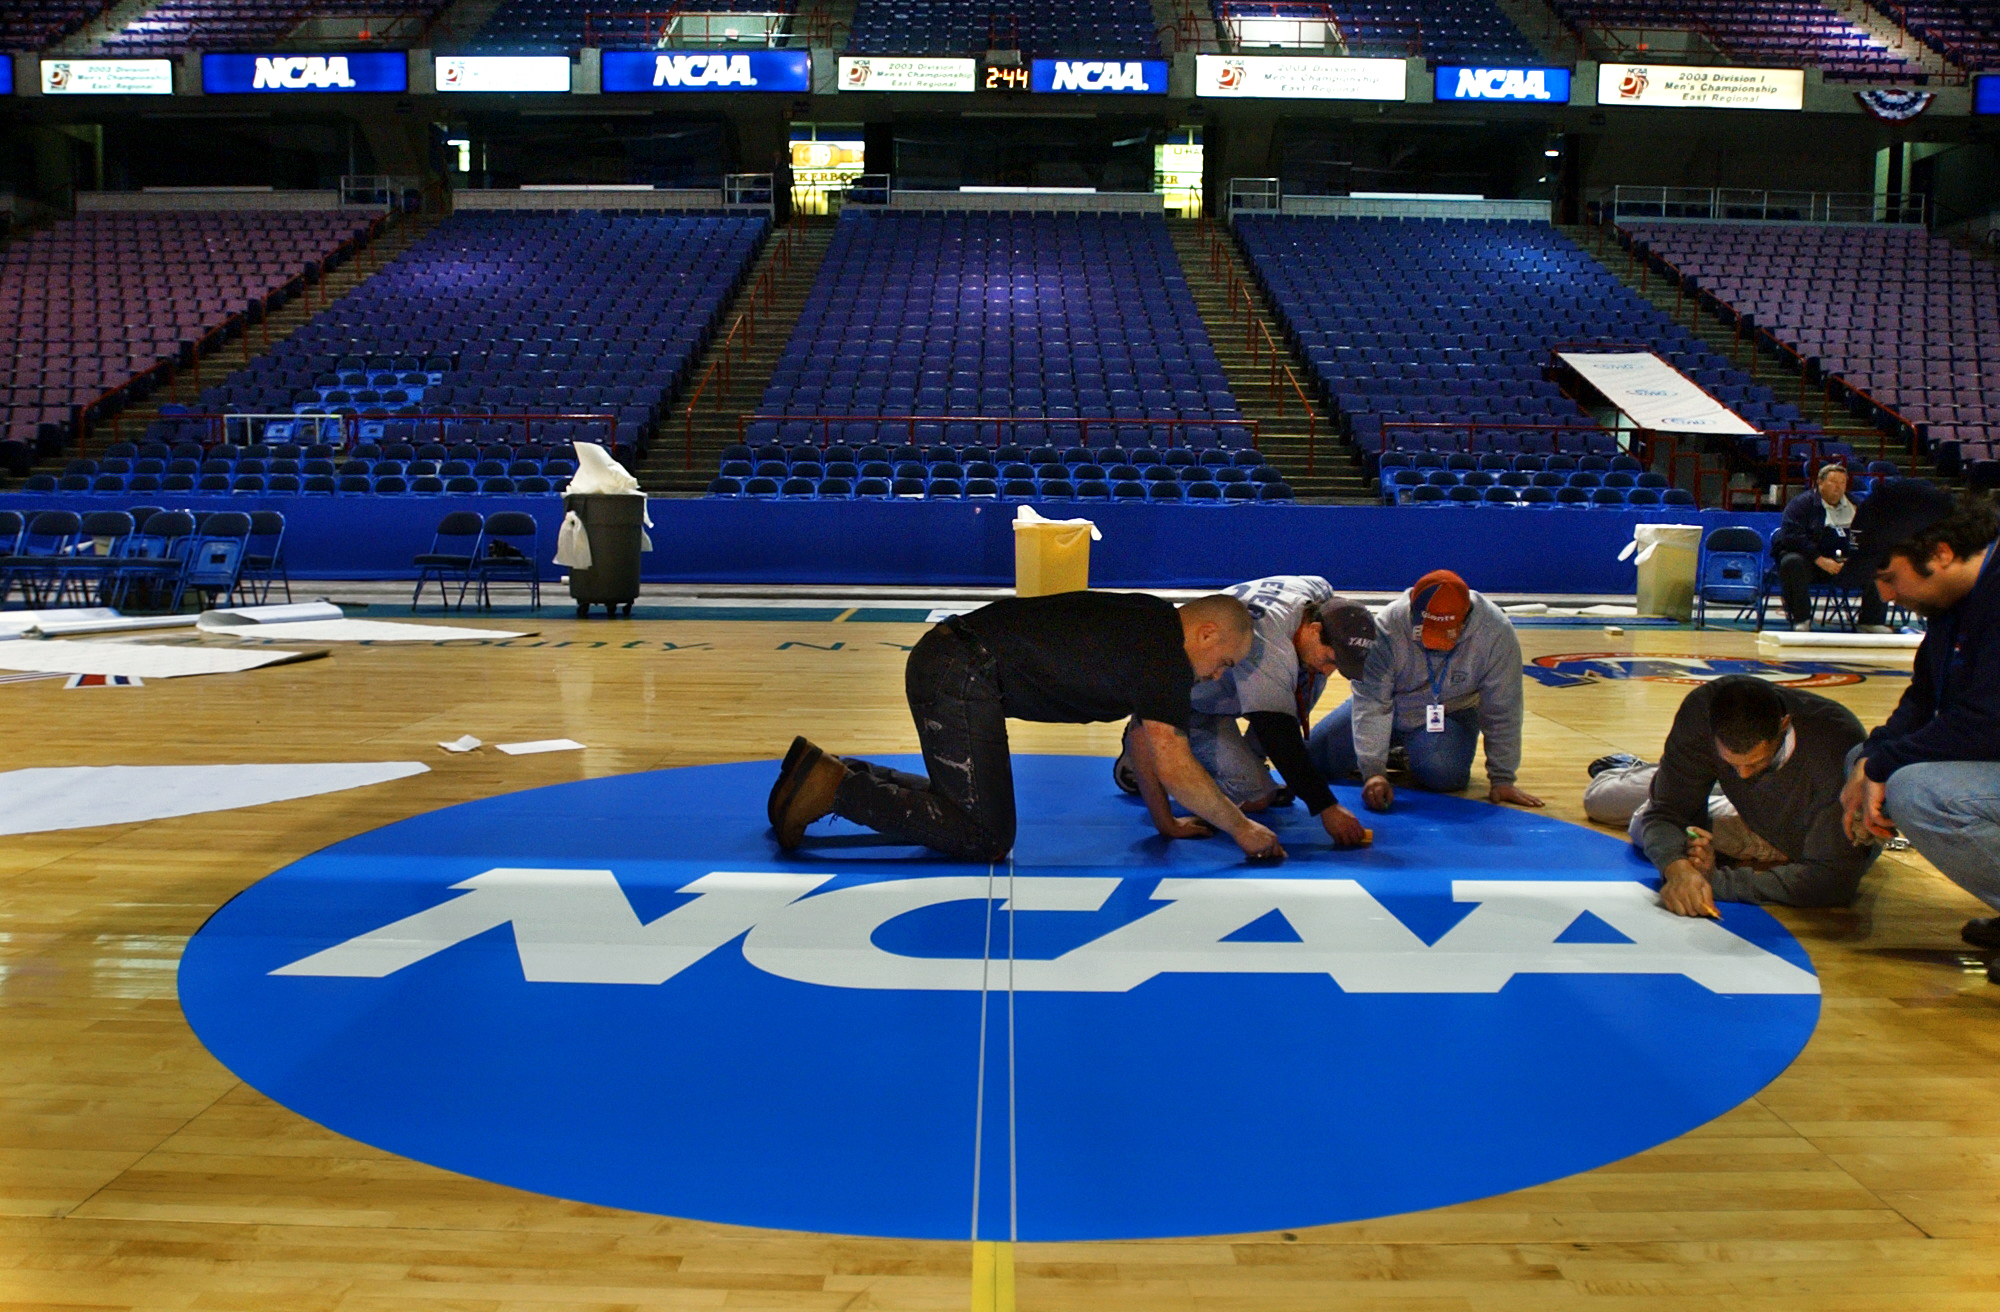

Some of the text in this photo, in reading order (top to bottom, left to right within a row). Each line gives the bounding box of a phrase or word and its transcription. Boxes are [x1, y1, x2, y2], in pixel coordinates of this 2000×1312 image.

[253, 56, 350, 89] NCAA
[652, 55, 751, 87] NCAA
[1278, 64, 1307, 72] 2003
[1312, 64, 1357, 73] Division
[907, 71, 973, 79] Championship
[1052, 61, 1143, 91] NCAA
[1300, 74, 1379, 83] Championship
[1679, 73, 1708, 81] 2003
[1712, 74, 1756, 83] Division
[916, 80, 957, 88] Regional
[1281, 84, 1360, 93] East Regional
[1455, 68, 1545, 99] NCAA
[1664, 82, 1778, 94] Men's Championship
[1682, 92, 1759, 103] East Regional
[266, 868, 1820, 995] NCAA
